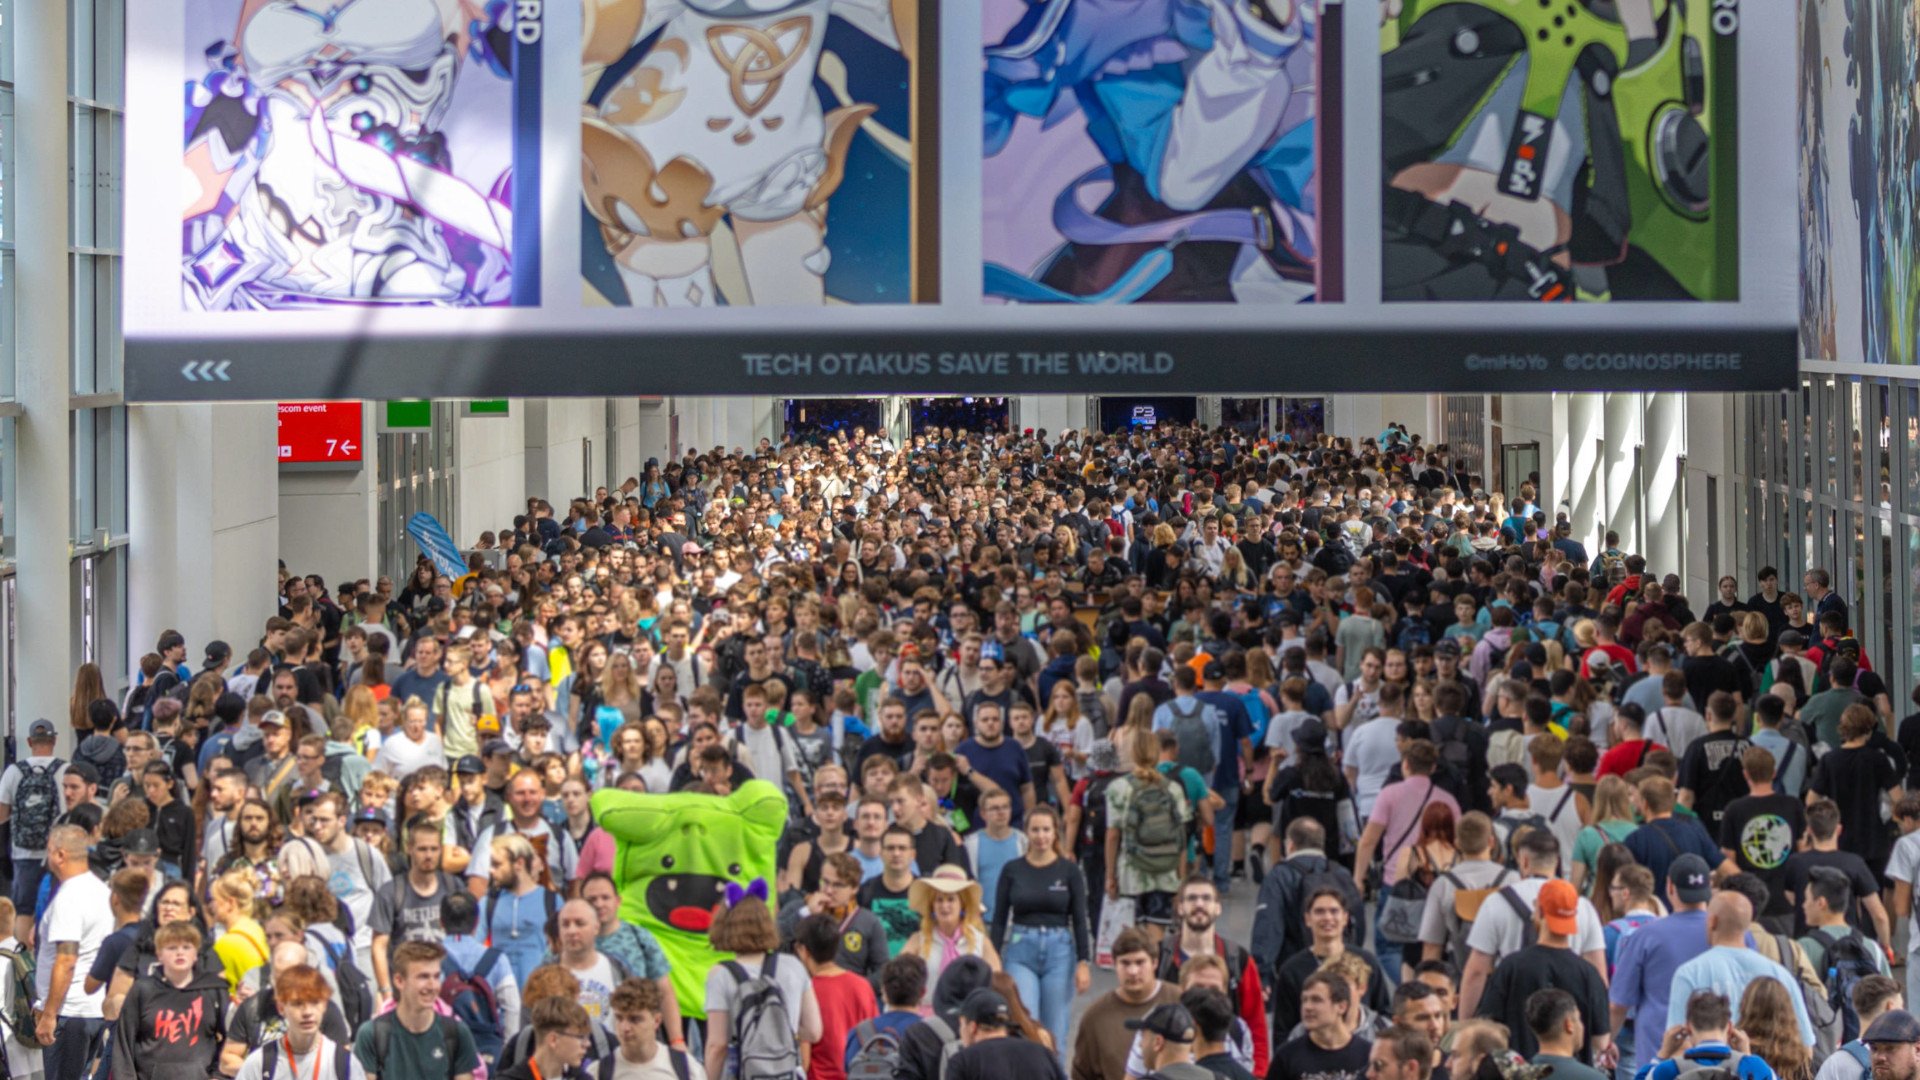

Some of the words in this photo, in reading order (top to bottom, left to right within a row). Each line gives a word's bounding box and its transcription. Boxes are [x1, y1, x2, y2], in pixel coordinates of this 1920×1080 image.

[742, 353, 812, 376] TECH
[818, 353, 932, 375] OTAKUS
[938, 353, 1010, 375] SAVE
[1017, 352, 1070, 375] THE
[1077, 351, 1174, 374] WORLD
[1464, 353, 1549, 372] ©miHoYo
[1563, 352, 1742, 372] ©COGNOSPHERE
[303, 404, 327, 413] event
[1133, 406, 1154, 416] P3
[326, 440, 337, 456] 7
[155, 996, 203, 1047] HEY!
